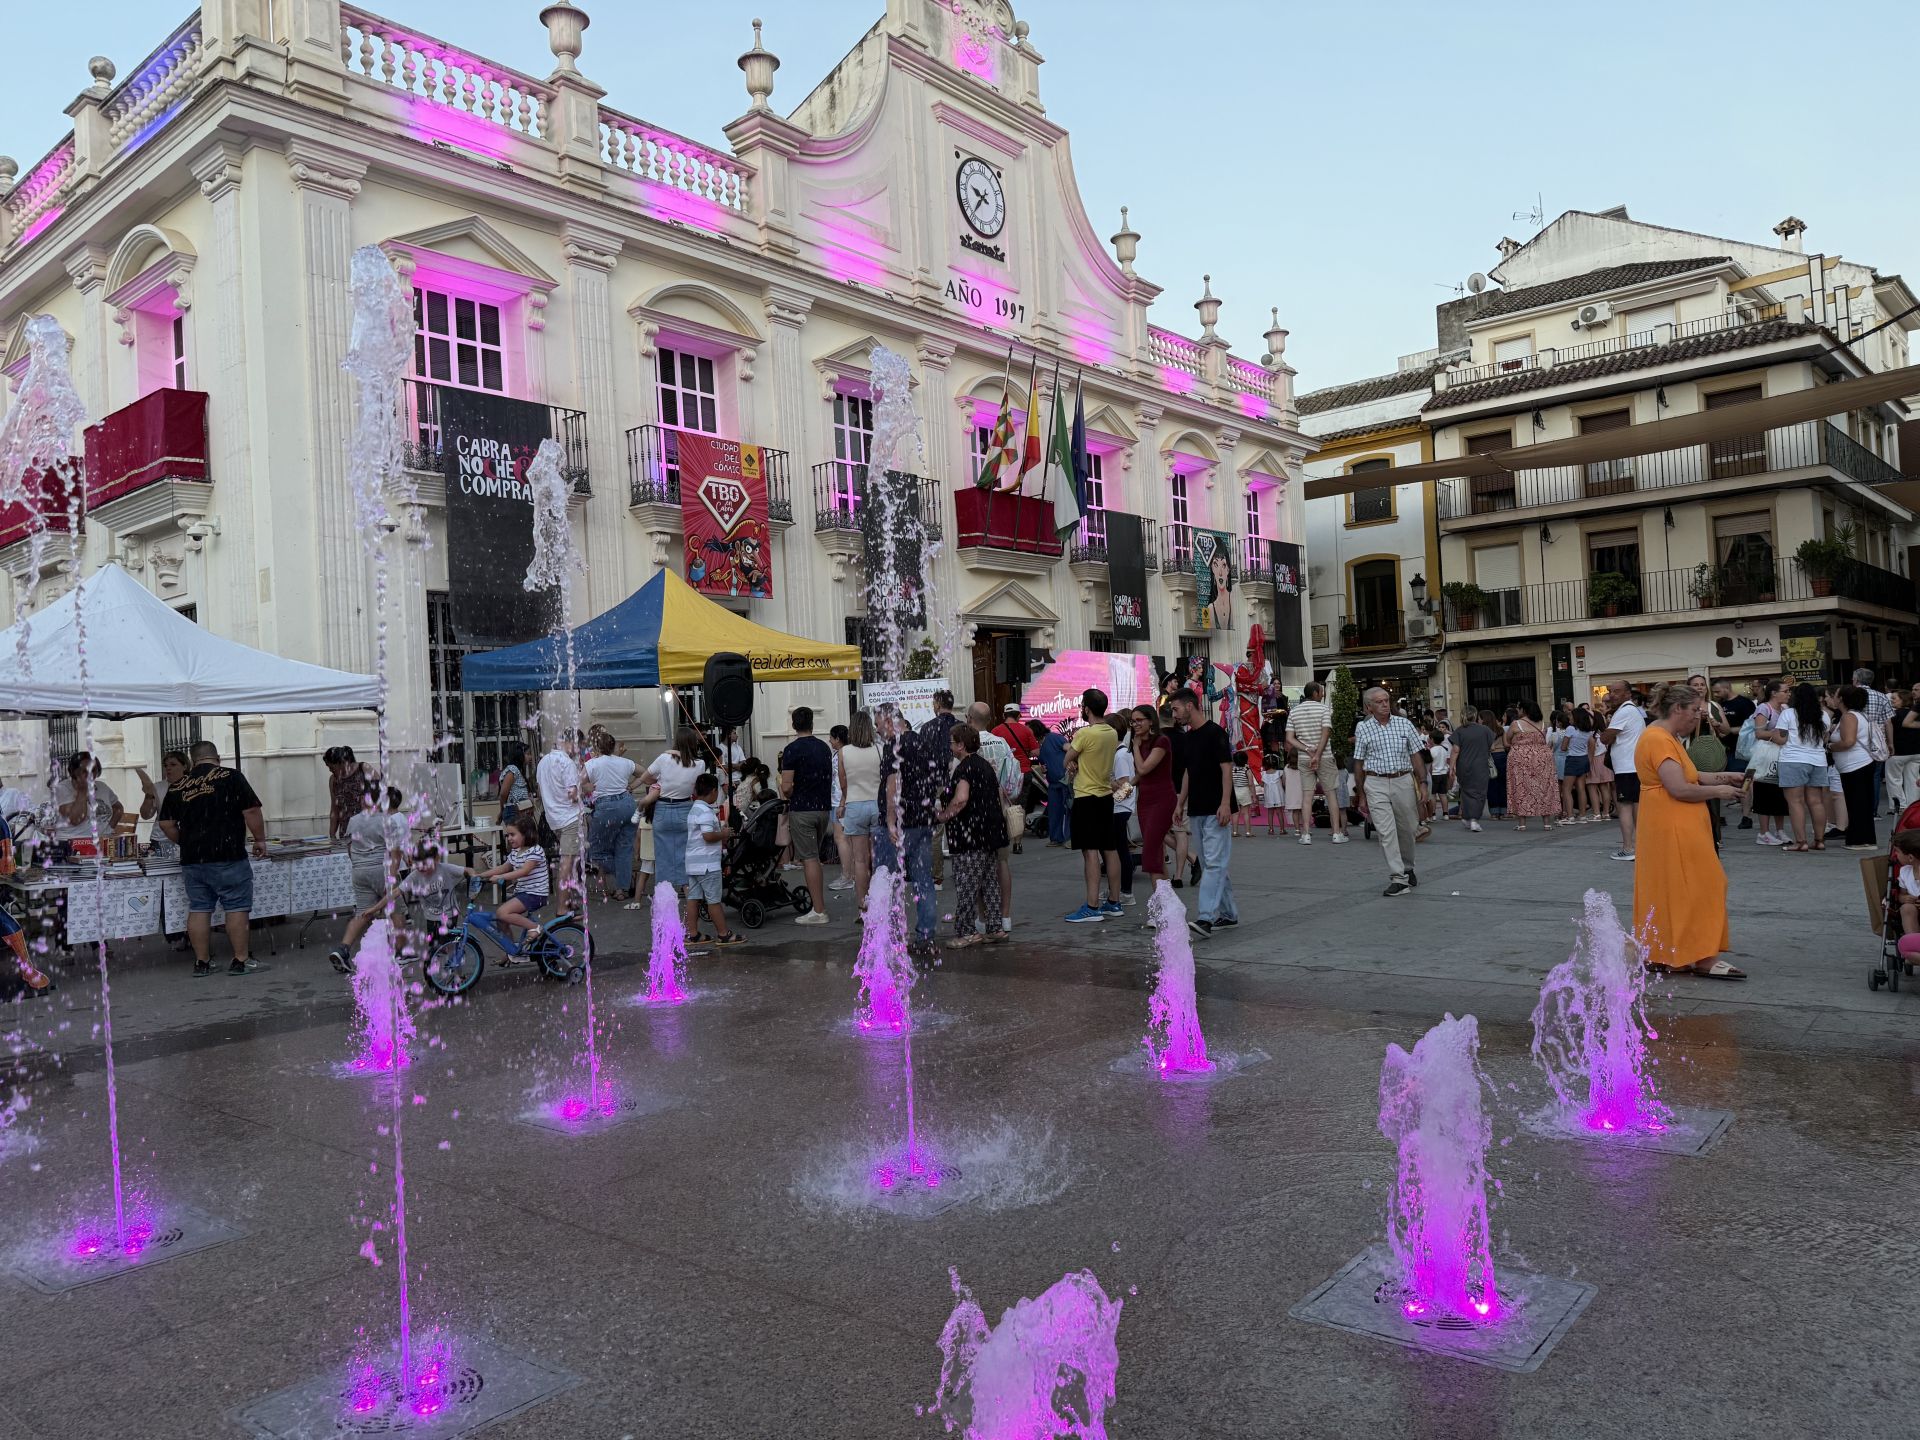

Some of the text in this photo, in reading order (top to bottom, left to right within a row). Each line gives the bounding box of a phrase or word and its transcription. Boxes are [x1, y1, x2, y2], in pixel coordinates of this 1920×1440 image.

[944, 278, 1025, 324] AÑO 1997
[456, 435, 512, 461] CABRA
[710, 440, 740, 452] CIUDAD
[724, 453, 740, 464] DEL
[713, 460, 741, 475] CÓMIC
[459, 474, 535, 506] COMPRA
[1114, 595, 1131, 605] CABRA
[1115, 615, 1141, 628] COMPRAS
[1737, 638, 1772, 648] NELA
[1788, 658, 1820, 671] ORO
[868, 689, 906, 698] ASOCIACIÓN
[906, 693, 935, 701] NECESIDA
[1029, 690, 1071, 718] encuentra
